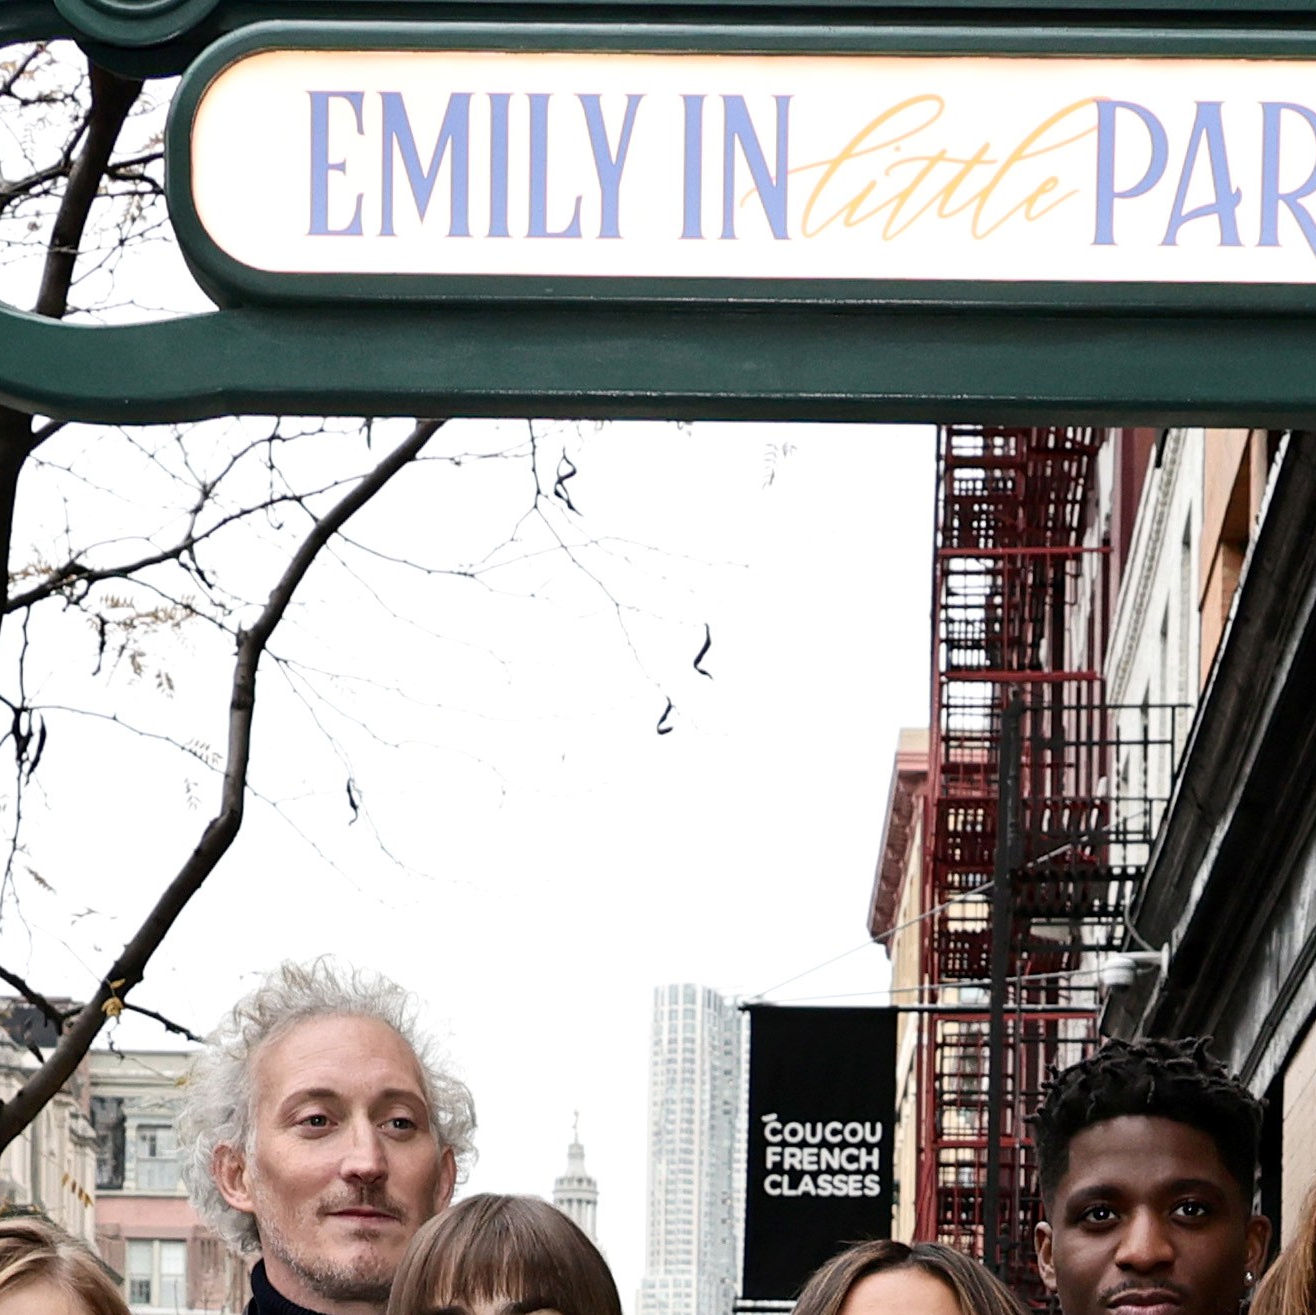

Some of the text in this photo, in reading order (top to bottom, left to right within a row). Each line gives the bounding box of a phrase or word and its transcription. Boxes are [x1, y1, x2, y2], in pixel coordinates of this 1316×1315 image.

[306, 89, 644, 239] EMILY
[678, 94, 794, 240] IN
[741, 94, 1110, 240] little
[765, 1147, 880, 1171] FRENCH
[764, 1174, 881, 1197] CLASSES
